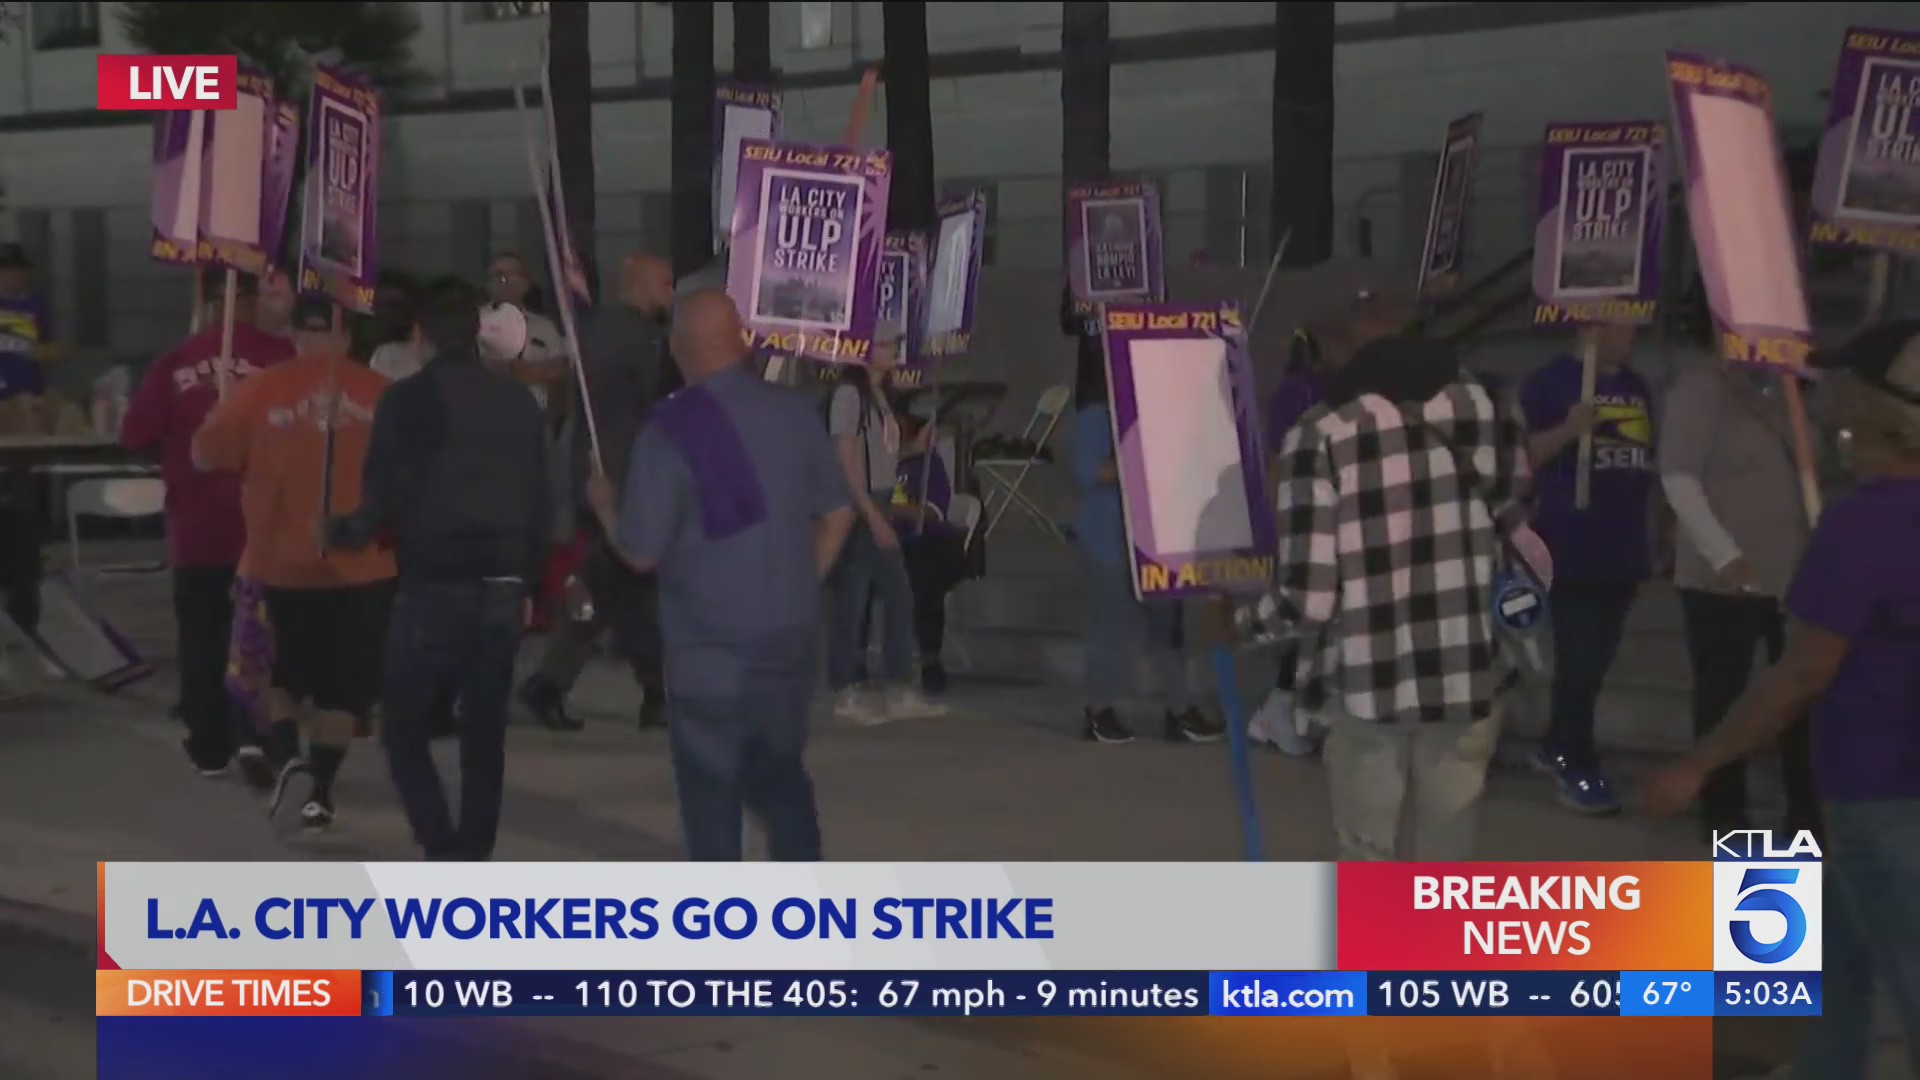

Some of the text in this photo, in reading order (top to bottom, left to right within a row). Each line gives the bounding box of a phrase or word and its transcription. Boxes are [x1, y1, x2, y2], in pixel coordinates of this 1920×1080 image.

[1872, 101, 1915, 140] UL
[744, 146, 861, 170] SEIU Local 721
[1578, 159, 1636, 178] LA CITY
[780, 184, 846, 208] LA CITY
[1576, 189, 1631, 221] ULP
[777, 215, 842, 251] ULP
[1572, 220, 1629, 240] STRIKE
[774, 249, 840, 273] STRIKE
[1148, 311, 1188, 331] Local
[1191, 311, 1217, 330] 721
[1534, 303, 1560, 324] IN
[760, 332, 871, 357] ACTION!
[1140, 563, 1170, 593] IN
